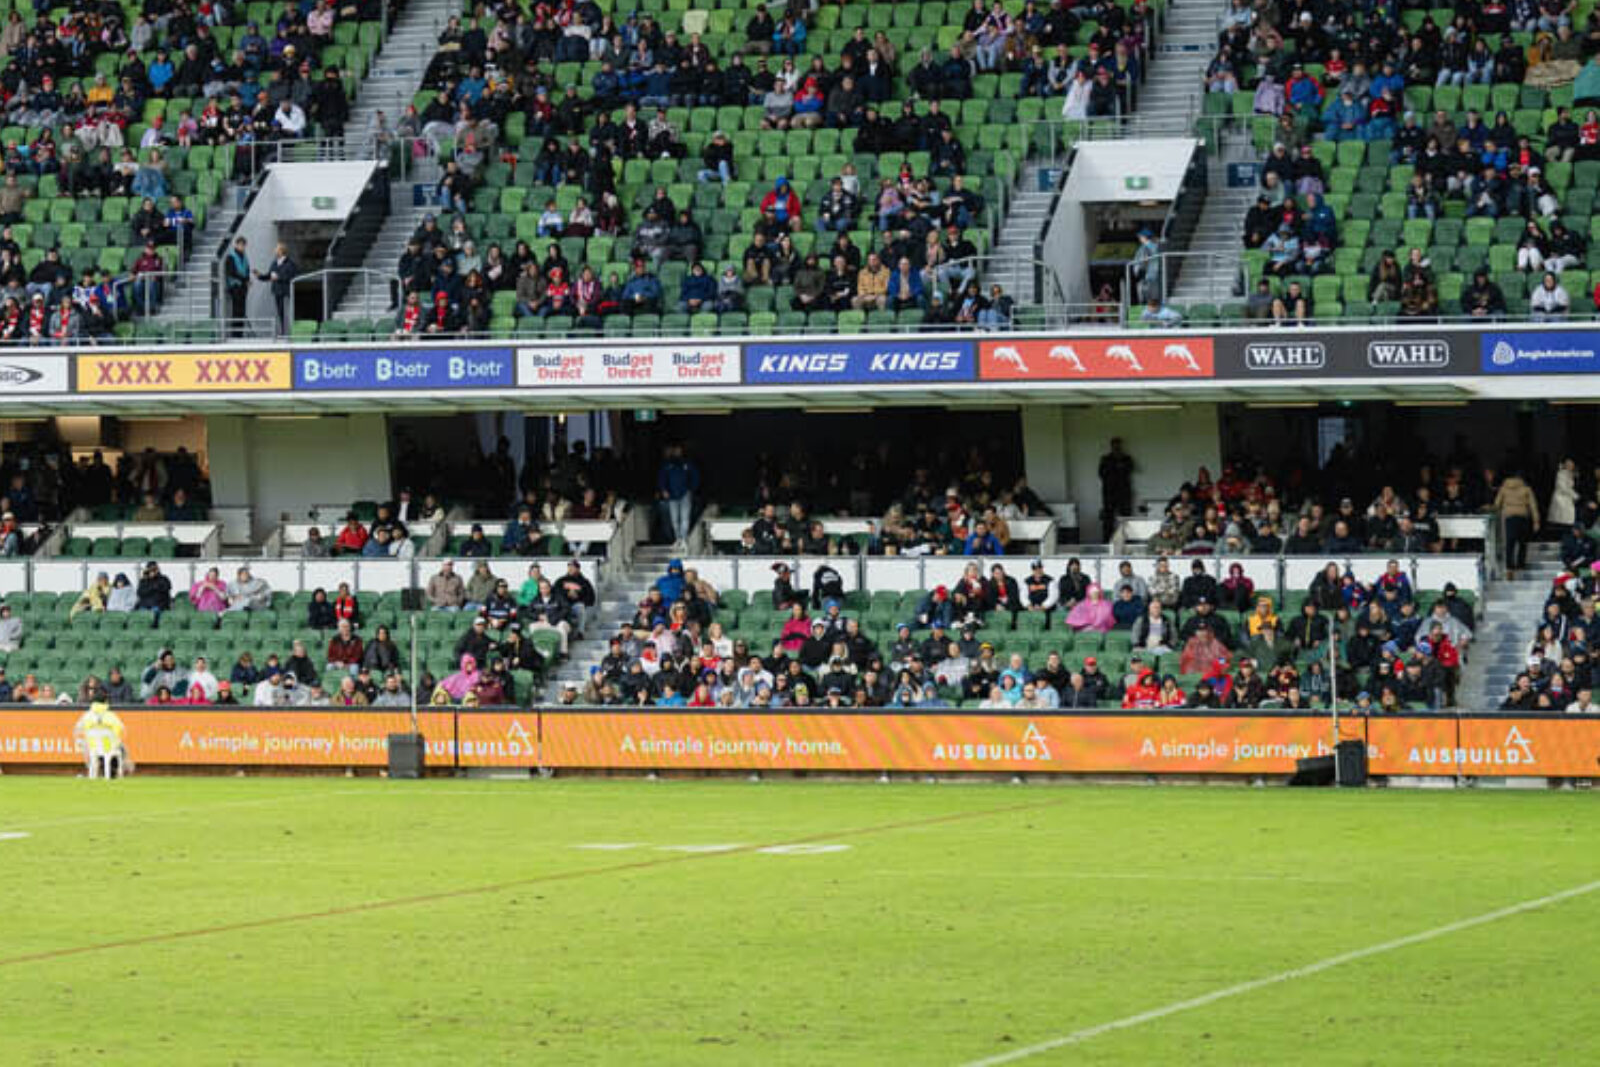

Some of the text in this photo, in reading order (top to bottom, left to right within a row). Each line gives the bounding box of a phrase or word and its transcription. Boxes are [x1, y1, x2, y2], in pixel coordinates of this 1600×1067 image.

[532, 354, 585, 369] Budget
[602, 353, 654, 369] Budget
[672, 351, 725, 368] Budget
[758, 351, 960, 373] KINGS KINGS
[1251, 342, 1444, 367] WAHL WAHL
[97, 359, 270, 385] XXXX XXXX
[322, 361, 359, 380] betr
[394, 361, 431, 379] betr
[467, 359, 504, 377] betr
[537, 366, 583, 381] Direct
[607, 365, 652, 380] Direct
[677, 364, 722, 379] Direct
[181, 731, 193, 748] A
[198, 731, 259, 753] simple
[263, 732, 332, 754] journey
[620, 735, 636, 753] A
[640, 734, 703, 757] simple
[708, 735, 781, 758] journey
[1141, 738, 1156, 756] A
[1162, 738, 1229, 760] simple
[1233, 738, 1311, 760] journey
[933, 743, 1038, 760] AUSBUILD
[1409, 747, 1520, 763] AUSBUILD
